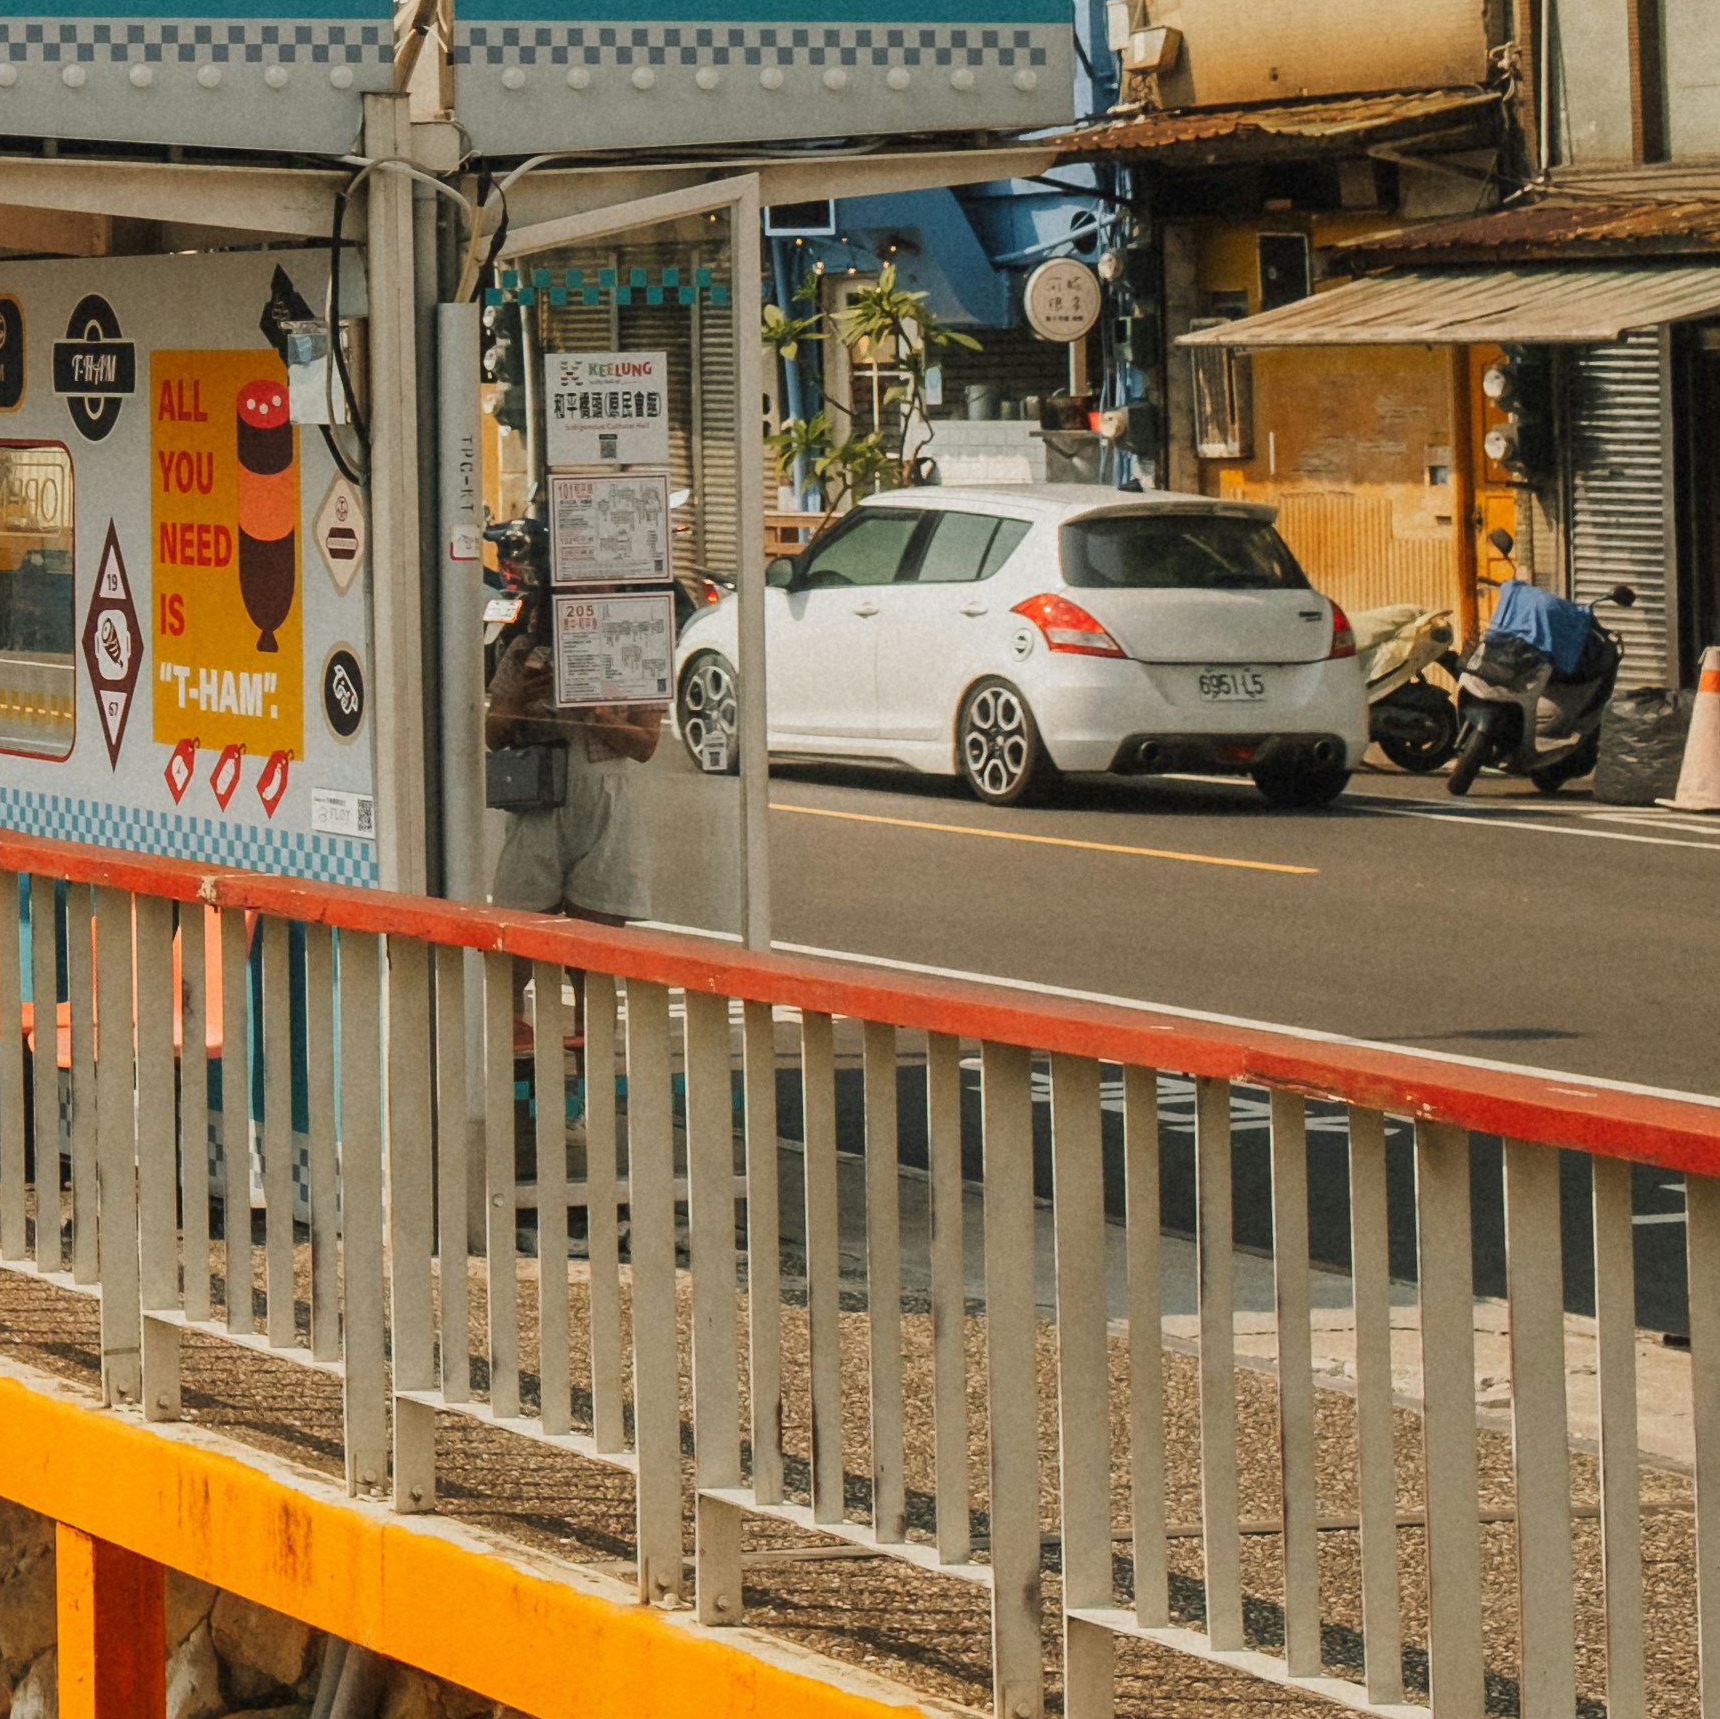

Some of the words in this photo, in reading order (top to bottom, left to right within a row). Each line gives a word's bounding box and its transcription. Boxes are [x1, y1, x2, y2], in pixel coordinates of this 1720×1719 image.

[588, 361, 653, 378] KEELUNG
[159, 379, 209, 423] ALL
[159, 451, 215, 495] YOU
[159, 523, 232, 568] NEED
[106, 573, 118, 591] 19
[159, 593, 185, 637] IS
[566, 604, 595, 618] 205
